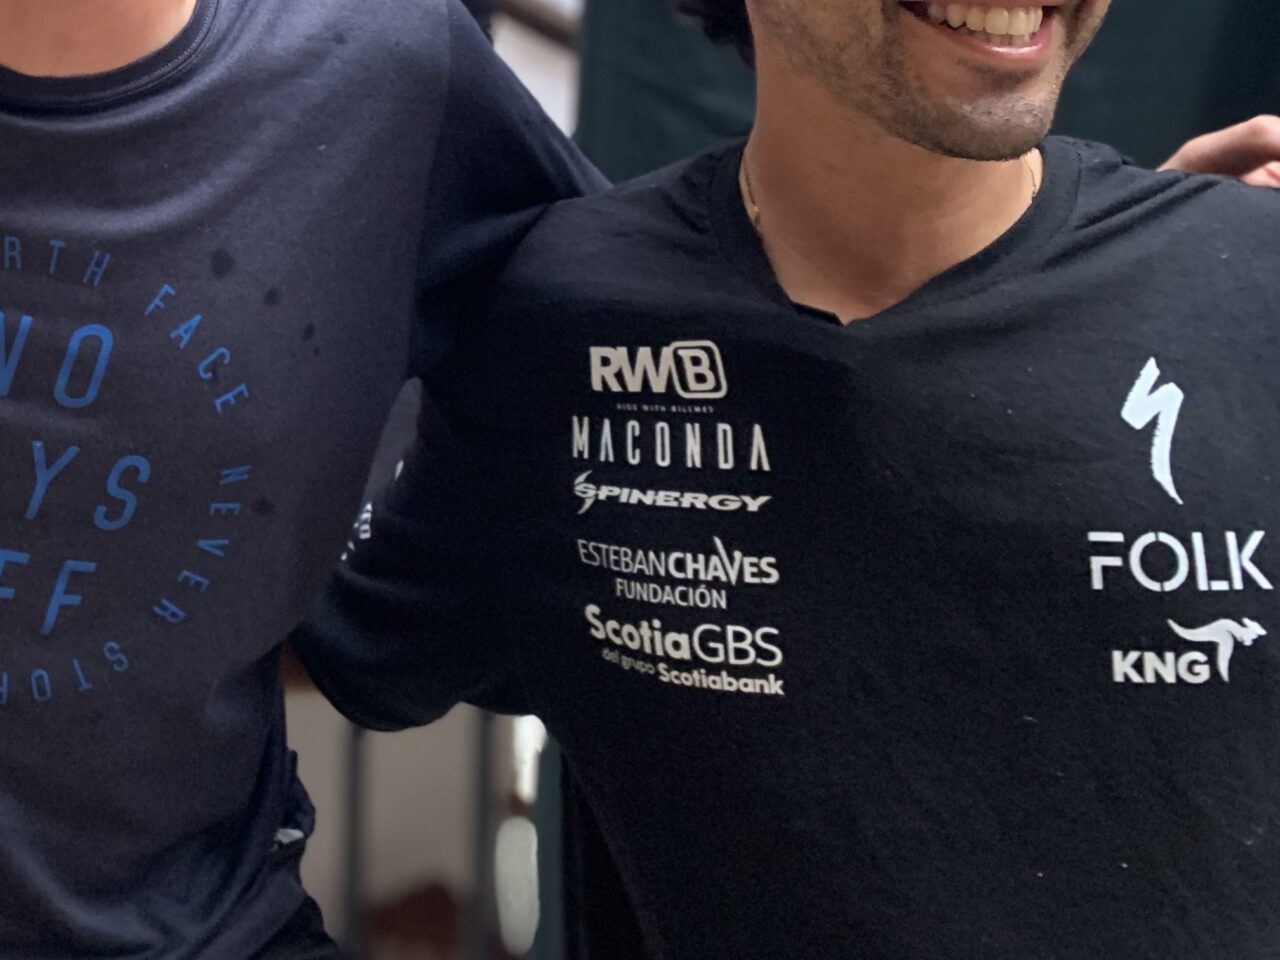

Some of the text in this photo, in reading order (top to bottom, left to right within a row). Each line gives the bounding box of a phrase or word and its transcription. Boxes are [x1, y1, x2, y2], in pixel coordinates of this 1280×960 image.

[143, 283, 250, 414] FACE
[589, 340, 728, 399] RWB
[572, 415, 771, 471] MACONDA
[574, 470, 772, 515] SPINERGY
[152, 464, 253, 625] NEVER
[1087, 530, 1274, 592] FOLK
[615, 578, 727, 610] FUNDACIÓN
[620, 656, 655, 675] grupo
[657, 662, 785, 696] Scotiabank
[1111, 650, 1210, 684] KNG
